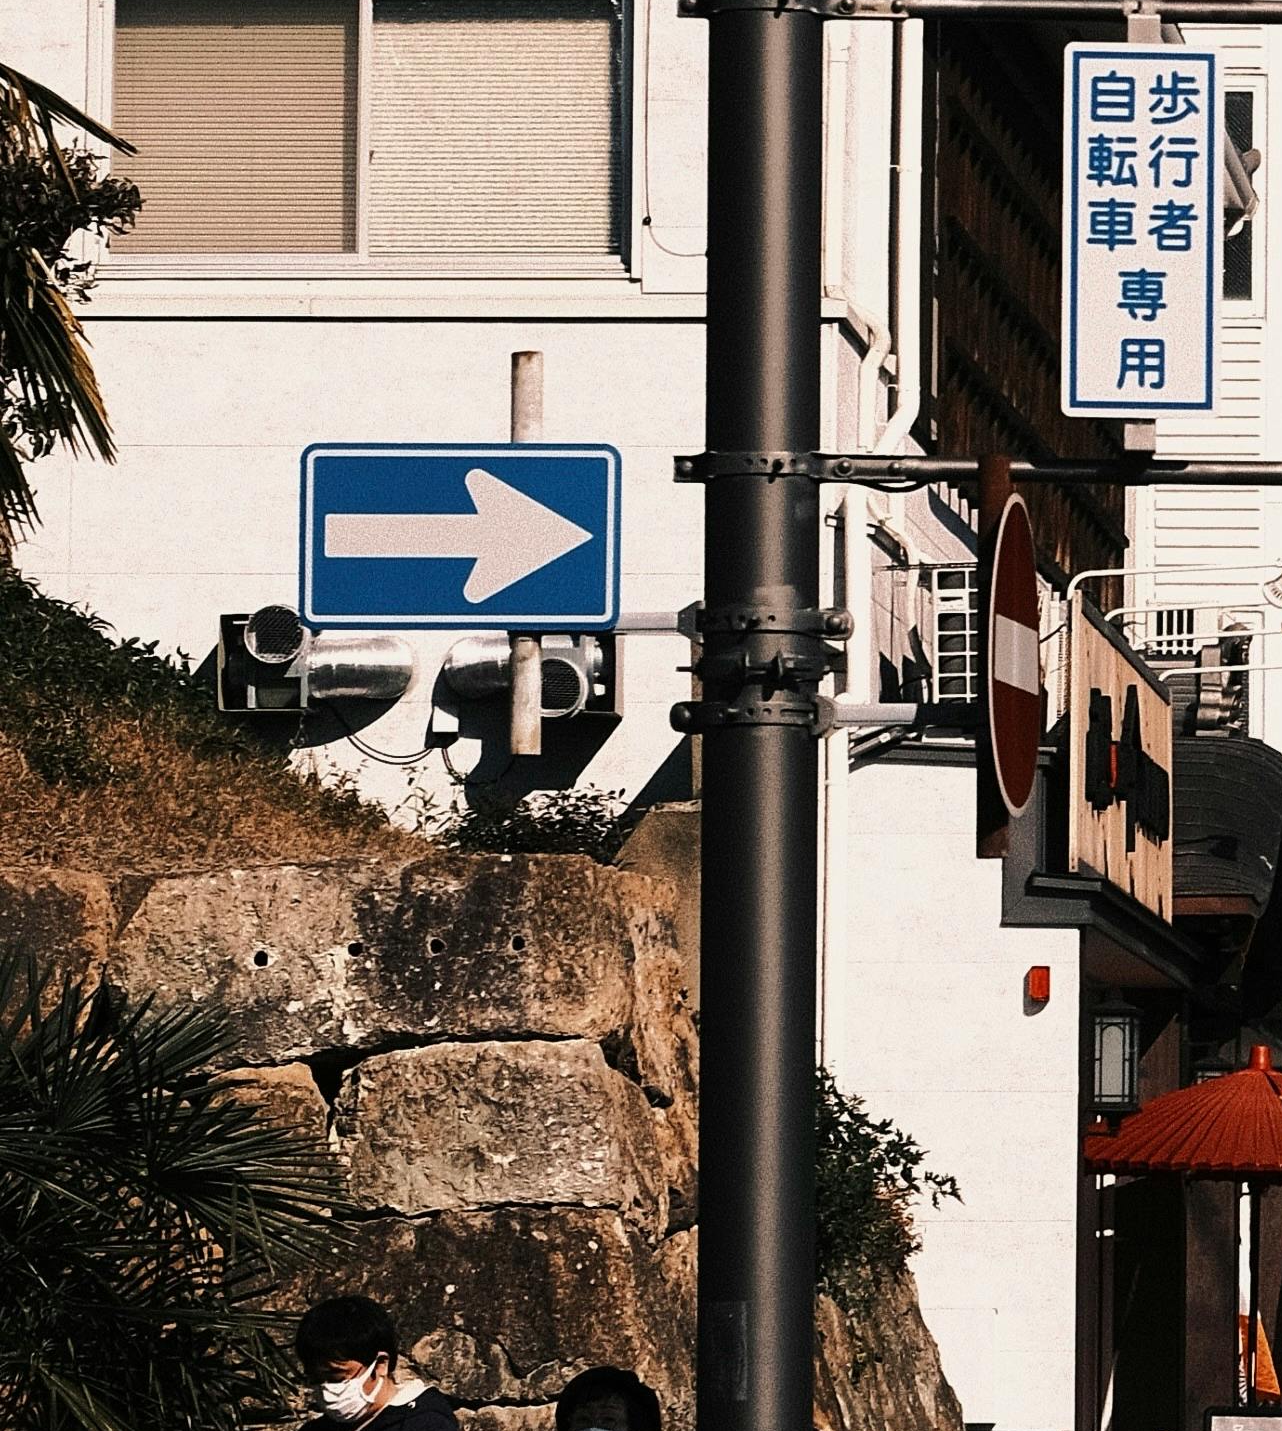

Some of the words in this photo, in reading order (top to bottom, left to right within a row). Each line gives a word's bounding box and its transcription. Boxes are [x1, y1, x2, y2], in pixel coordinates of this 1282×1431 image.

[1086, 71, 1138, 252] 自転車
[1149, 71, 1199, 252] 歩行者
[1117, 268, 1168, 391] 専用
